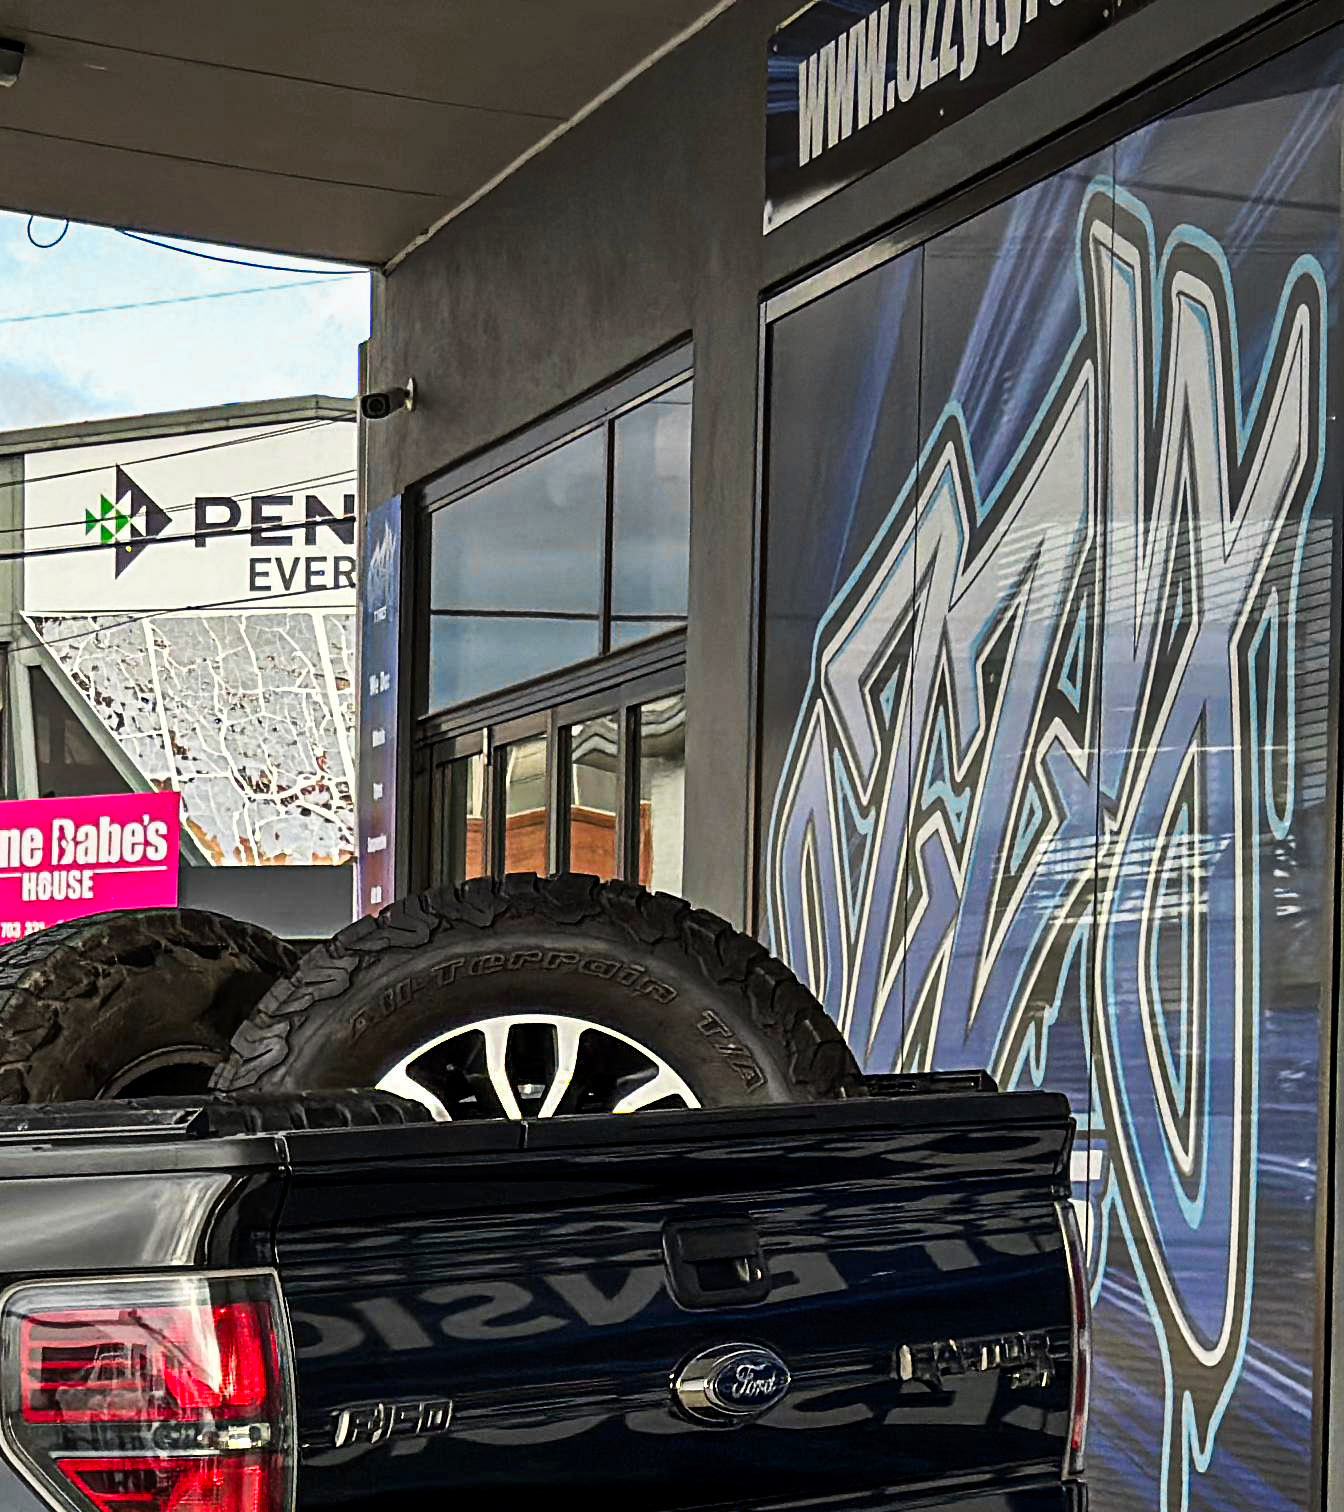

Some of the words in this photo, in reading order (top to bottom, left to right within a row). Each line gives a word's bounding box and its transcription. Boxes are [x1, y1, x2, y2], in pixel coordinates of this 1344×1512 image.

[195, 494, 356, 547] PEN
[249, 556, 356, 592] EVER
[50, 814, 168, 866] Babe's
[22, 870, 94, 902] HOUSE
[732, 1363, 778, 1399] Ford
